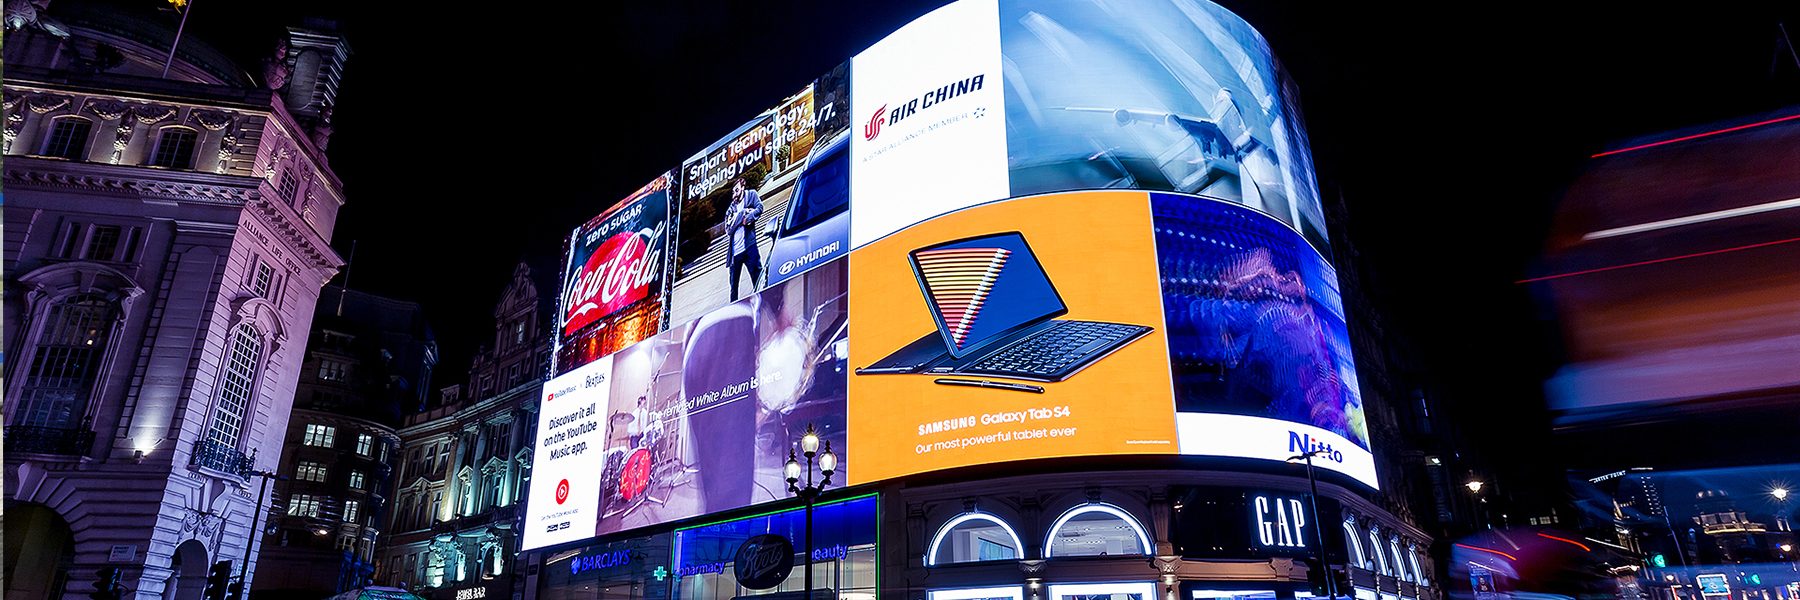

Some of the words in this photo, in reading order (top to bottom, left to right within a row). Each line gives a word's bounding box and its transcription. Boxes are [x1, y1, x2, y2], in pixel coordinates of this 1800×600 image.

[888, 98, 918, 127] AIR
[922, 73, 985, 109] CHINA
[928, 112, 968, 131] MEMBER
[688, 161, 736, 199] keeping
[738, 147, 763, 173] you
[764, 128, 795, 154] safe
[797, 102, 836, 136] 24/7.
[689, 148, 728, 181] Smart
[728, 102, 809, 157] Technology,
[585, 223, 609, 247] zero
[610, 204, 643, 230] SUGAR
[243, 219, 269, 247] ALLIANCE
[271, 245, 283, 259] LIFE
[285, 257, 301, 276] OFFICE
[796, 240, 840, 268] HYUNDAI
[561, 220, 667, 328] Coca-Cola
[649, 409, 661, 422] The
[695, 390, 720, 407] White
[720, 381, 749, 400] Album
[750, 376, 759, 389] is
[760, 371, 783, 386] here.
[549, 411, 578, 430] Discover
[579, 407, 585, 419] it
[585, 402, 596, 417] all
[918, 415, 976, 436] SAMSUNG
[980, 410, 1027, 425] Galaxy
[1027, 407, 1053, 420] Tab
[1053, 405, 1071, 418] S4
[544, 436, 553, 447] on
[554, 431, 566, 444] the
[567, 420, 597, 440] YouTube
[915, 443, 932, 454] Our
[934, 437, 961, 451] most
[961, 430, 1011, 449] powerful
[1013, 428, 1048, 440] tablet
[1049, 426, 1077, 438] ever
[1287, 430, 1343, 463] Nitto
[549, 444, 571, 461] Music
[571, 441, 587, 456] app.
[1255, 496, 1306, 548] GAP
[581, 549, 632, 572] BARCLAYS
[738, 541, 784, 581] Boots
[812, 543, 848, 560] eauty
[679, 561, 725, 579] pharmacy
